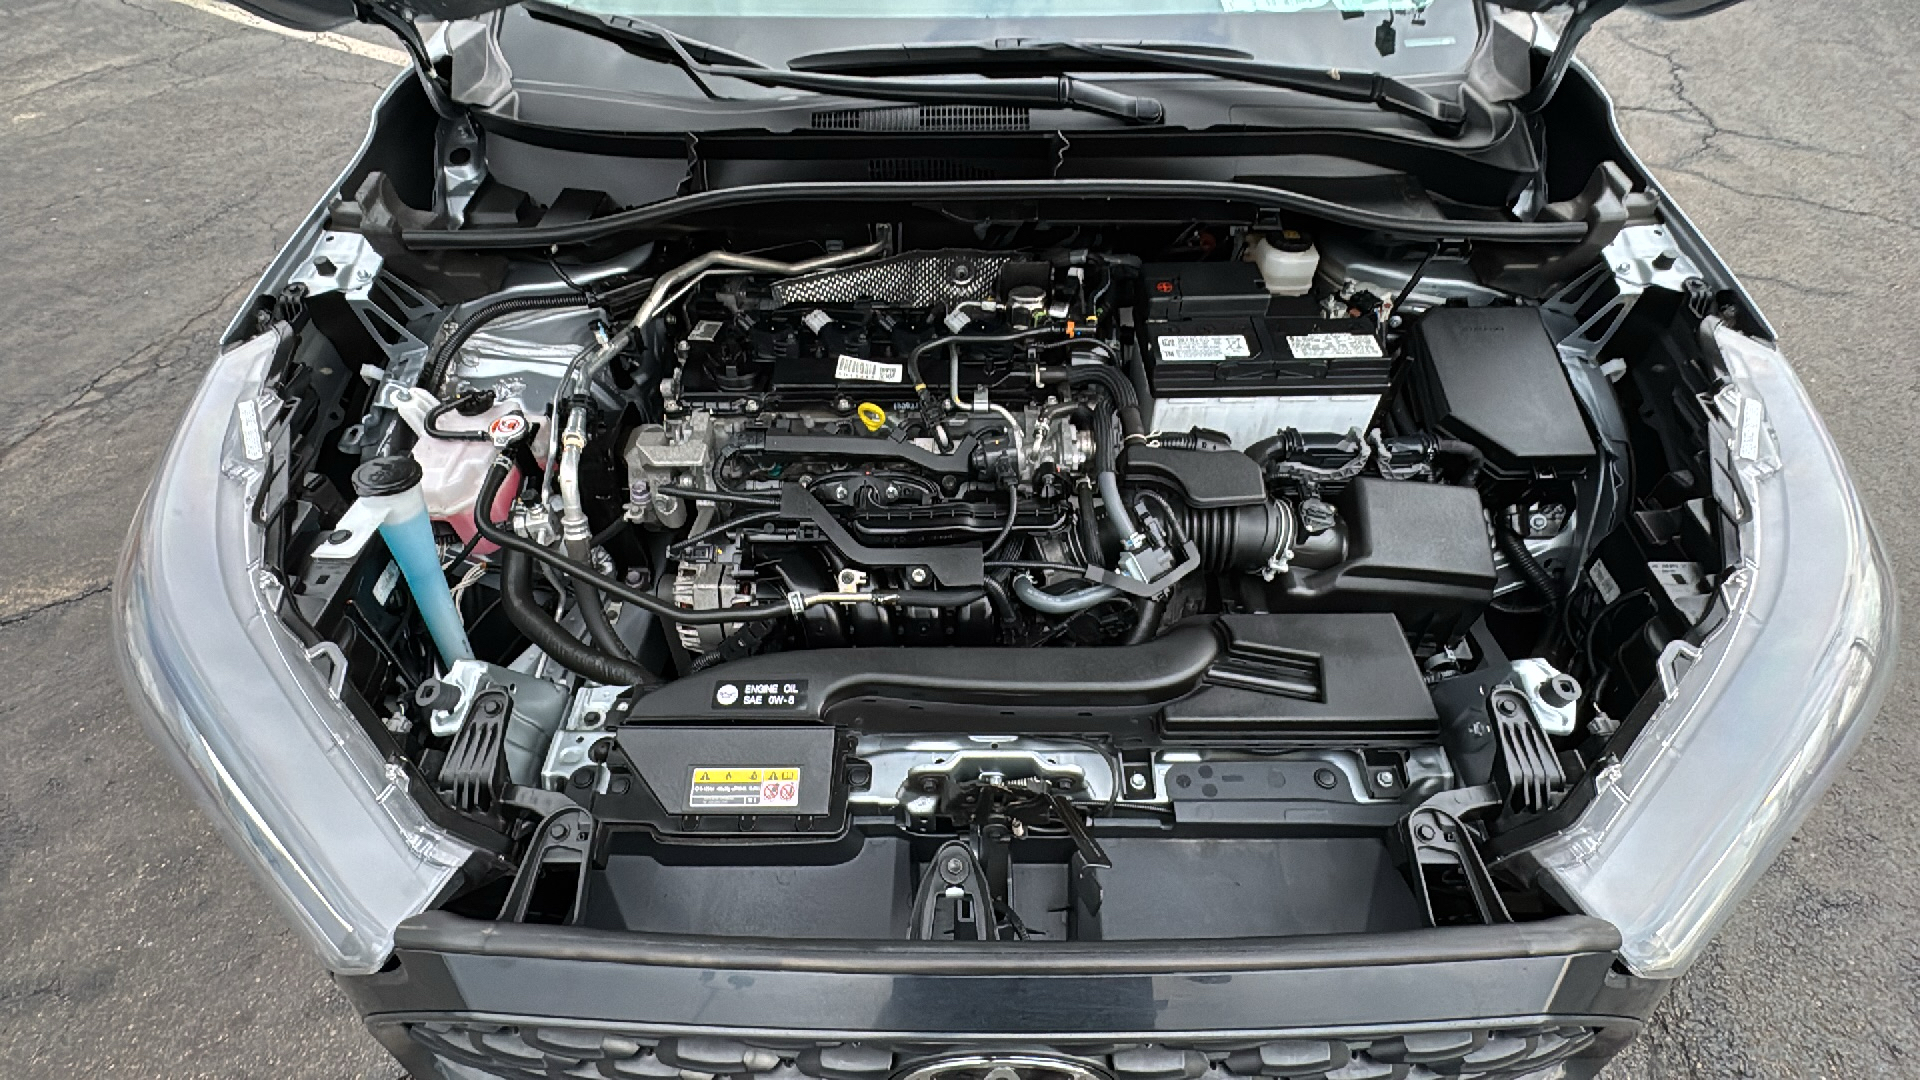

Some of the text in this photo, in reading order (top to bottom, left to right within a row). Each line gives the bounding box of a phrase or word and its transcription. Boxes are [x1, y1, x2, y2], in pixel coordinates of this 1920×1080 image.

[745, 684, 799, 694] ENGINE OIL
[743, 695, 795, 705] SAE 0W-8
